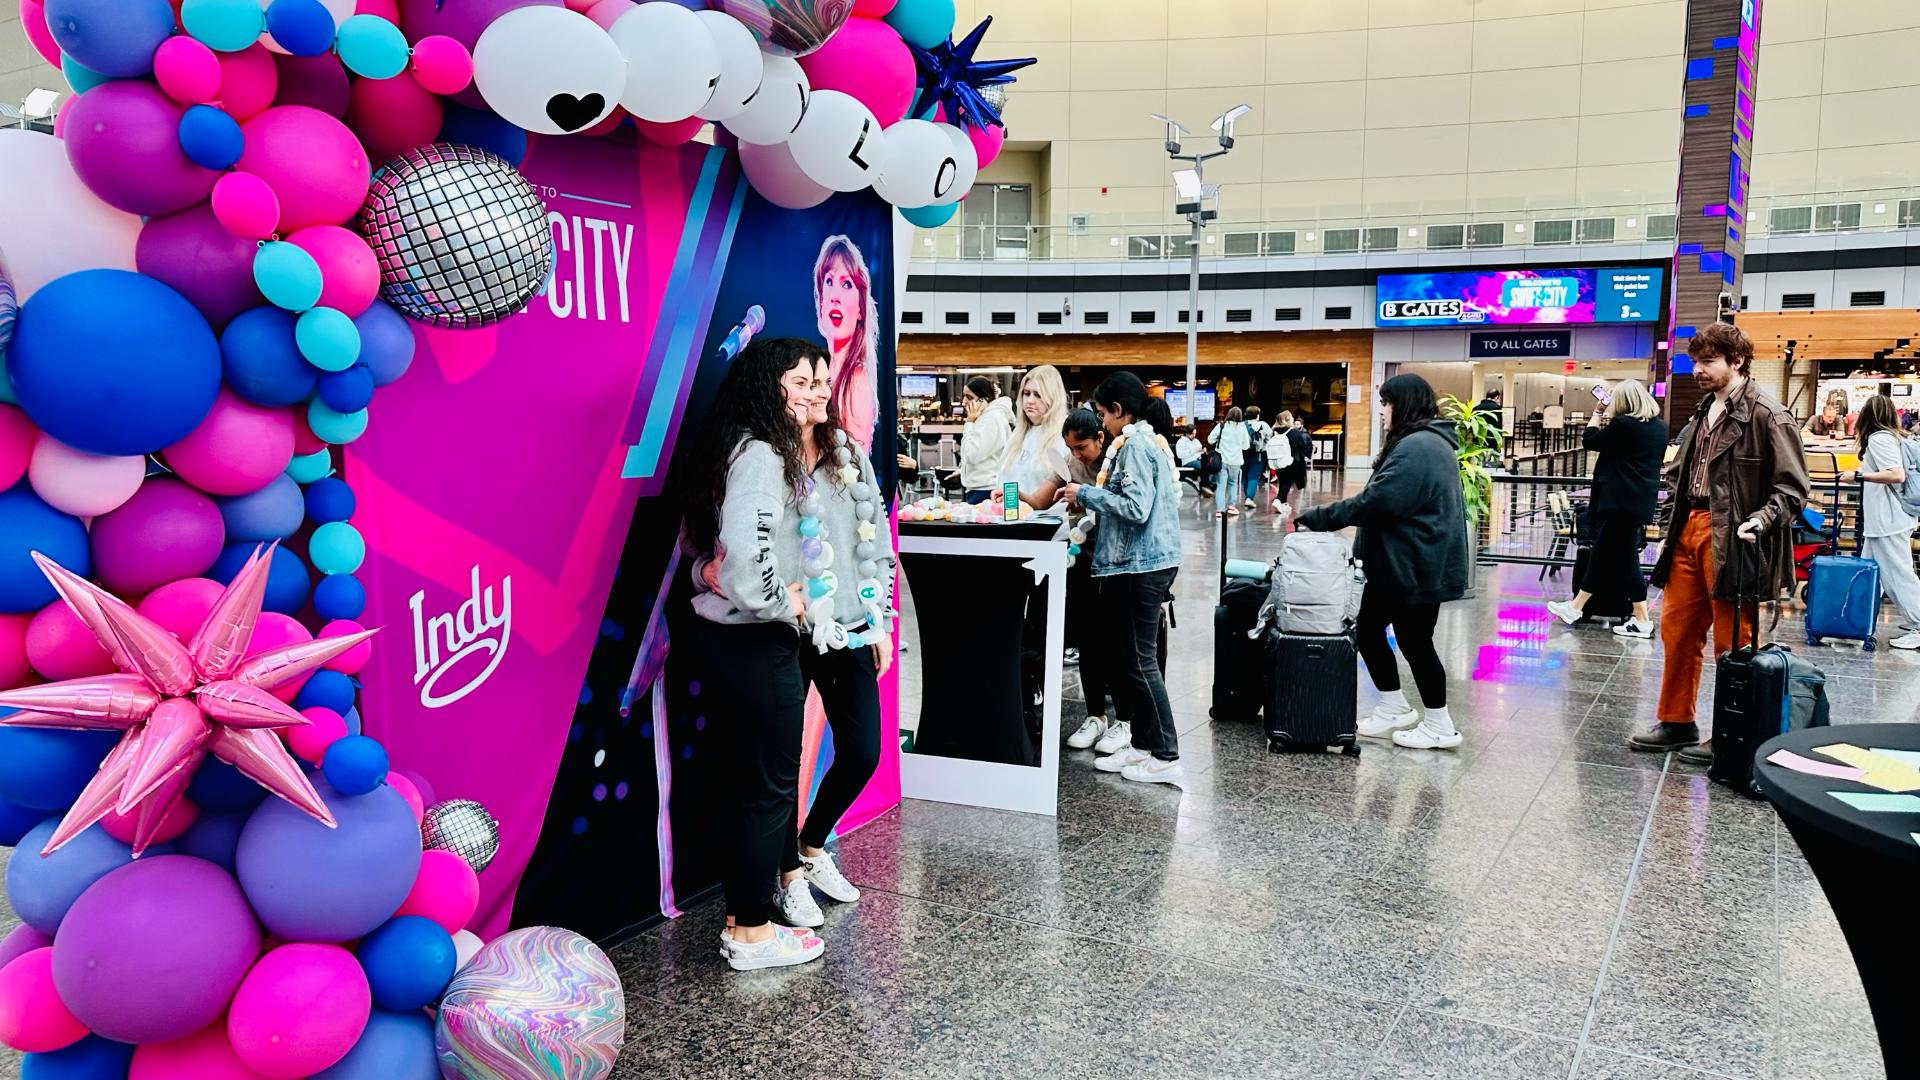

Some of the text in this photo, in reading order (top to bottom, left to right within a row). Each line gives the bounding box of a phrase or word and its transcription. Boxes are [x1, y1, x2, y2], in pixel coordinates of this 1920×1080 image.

[541, 185, 557, 199] TO
[547, 210, 634, 323] CITY
[1518, 279, 1552, 287] WELCOME
[1509, 285, 1568, 308] SWIFT CITY
[1385, 301, 1460, 317] B GATES
[1620, 304, 1630, 319] 3
[1482, 339, 1558, 350] TO ALL GATES
[409, 563, 512, 709] Indy
